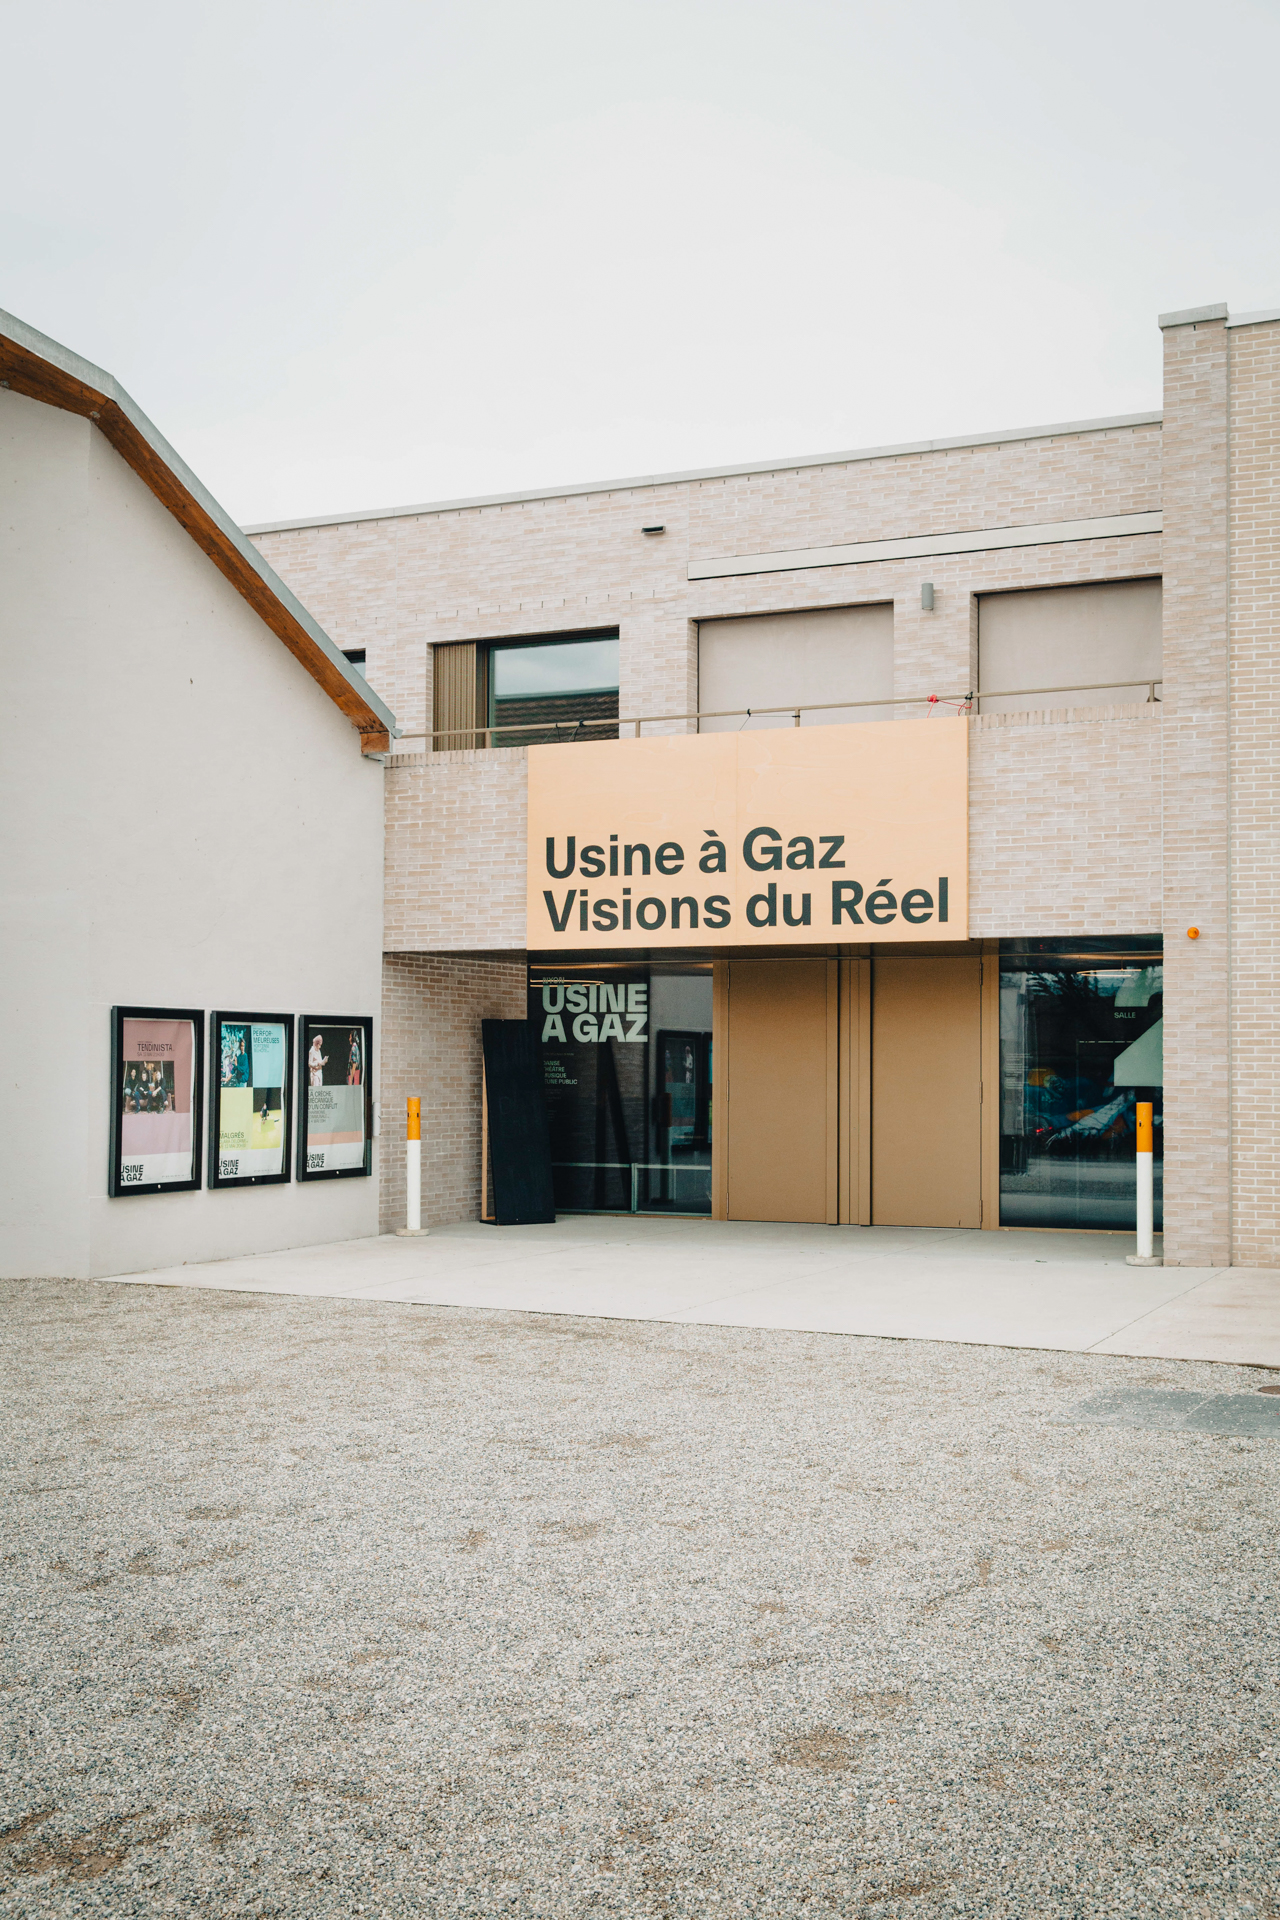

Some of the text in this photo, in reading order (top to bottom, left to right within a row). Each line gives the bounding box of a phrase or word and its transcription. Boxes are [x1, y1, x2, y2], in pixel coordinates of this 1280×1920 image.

[544, 826, 846, 880] Usine à Gaz
[543, 876, 950, 932] Visions du Réel
[542, 983, 648, 1013] USINE
[541, 1013, 649, 1043] A GAZ
[1114, 1011, 1136, 1019] SALLE
[126, 1173, 143, 1182] GAZ
[223, 1167, 239, 1176] GAZ
